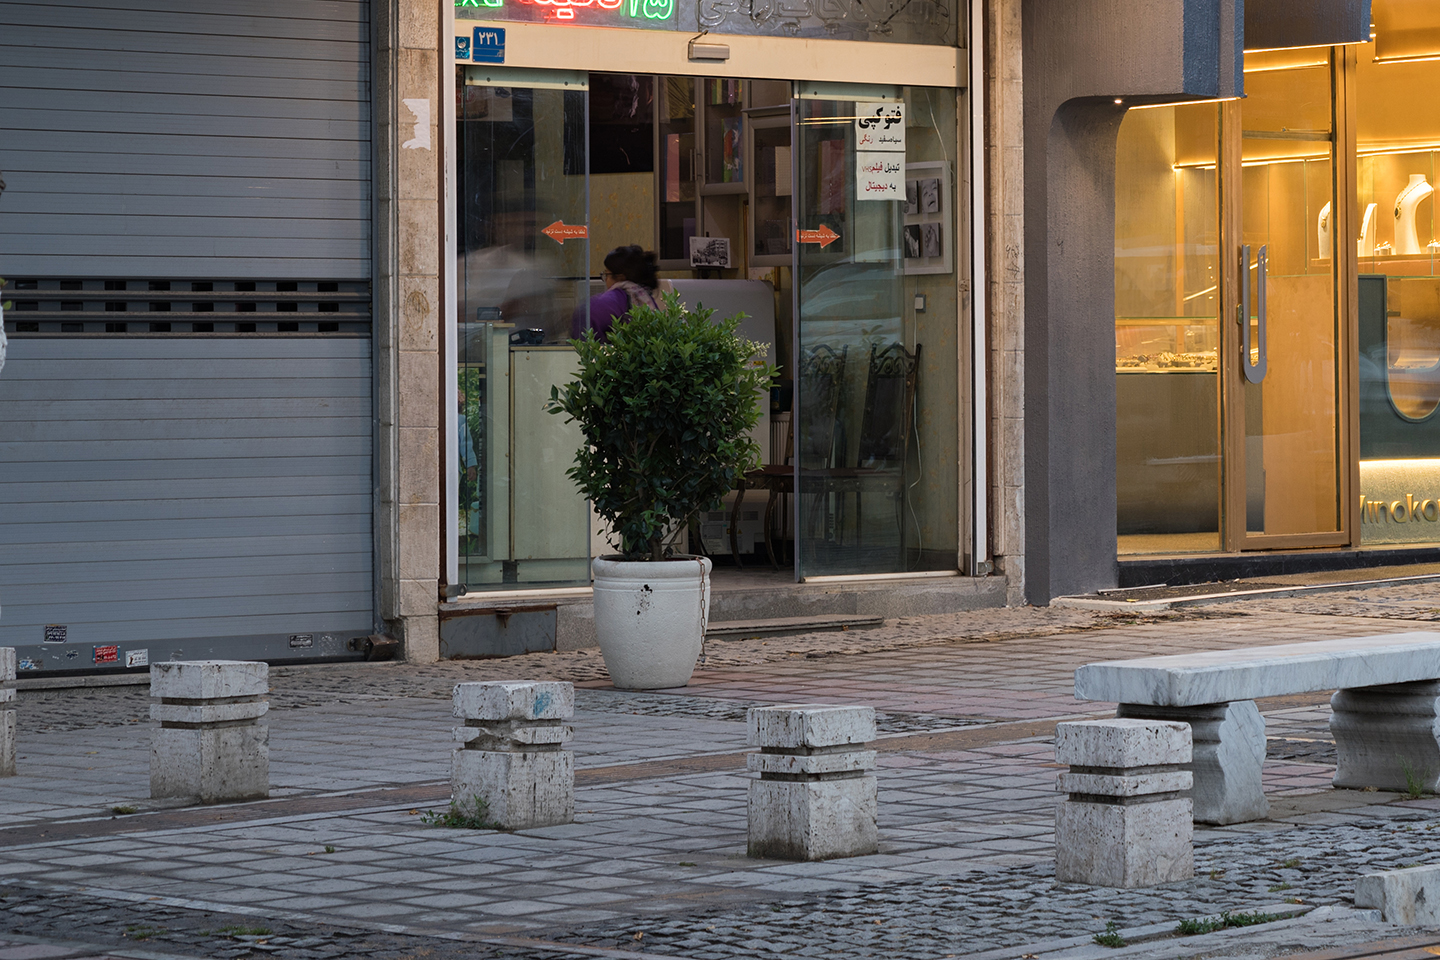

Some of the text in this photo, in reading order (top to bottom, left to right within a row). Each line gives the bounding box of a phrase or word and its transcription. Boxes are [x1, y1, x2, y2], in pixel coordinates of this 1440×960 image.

[478, 31, 498, 45] ۲۳۱
[859, 134, 873, 145] رنگی
[884, 163, 900, 174] تبدیل
[865, 181, 897, 192] به دیجیتال
